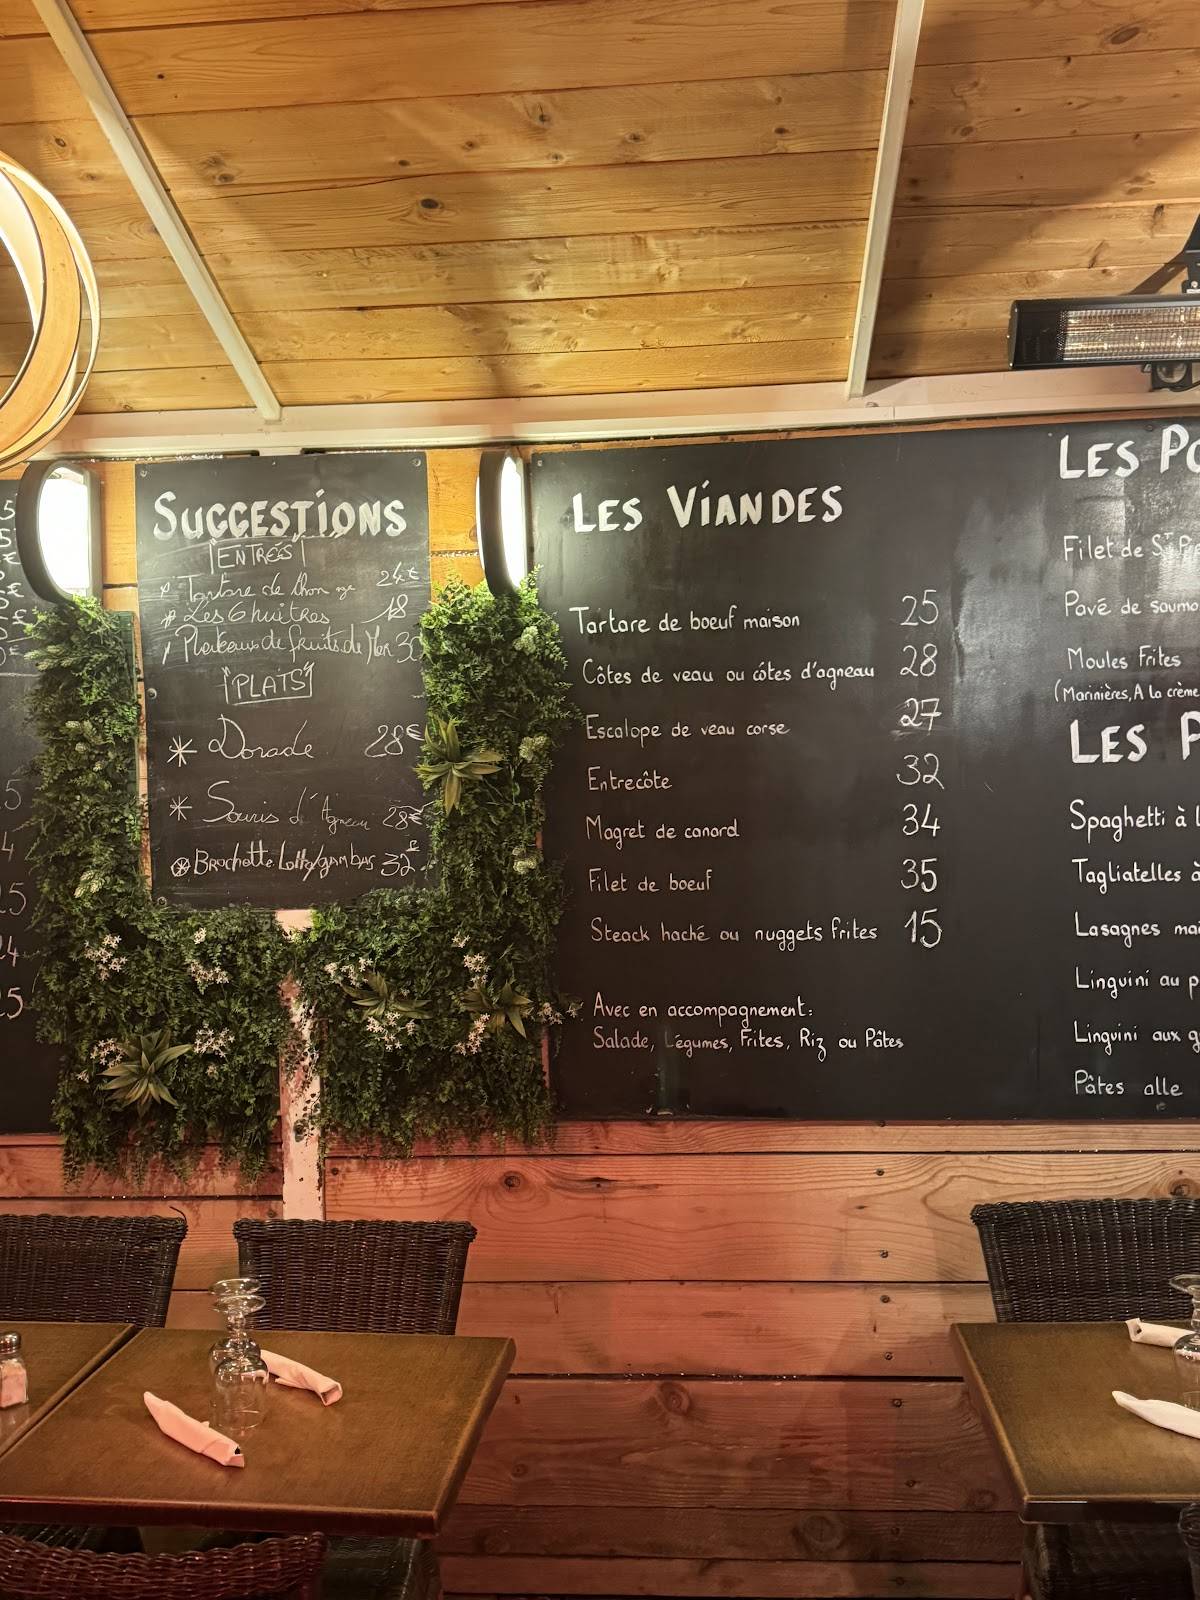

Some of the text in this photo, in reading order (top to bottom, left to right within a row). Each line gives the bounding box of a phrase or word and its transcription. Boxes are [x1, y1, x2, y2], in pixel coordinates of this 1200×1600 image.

[1060, 434, 1140, 480] LES
[572, 492, 643, 533] LES
[1063, 535, 1113, 561] Filet
[1121, 538, 1144, 558] de
[262, 572, 284, 597] de
[1065, 590, 1112, 617] Pavé
[1121, 597, 1142, 615] de
[183, 601, 224, 625] Les
[569, 606, 650, 635] Tartare
[658, 612, 682, 632] de
[743, 608, 800, 631] maison
[900, 589, 939, 626] 25
[582, 658, 632, 685] Côtes
[641, 666, 663, 683] de
[673, 669, 715, 683] veau
[726, 669, 745, 682] ou
[800, 661, 875, 691] d'agneau
[900, 643, 938, 677] 28
[1067, 645, 1182, 670] Moules Frites
[1149, 685, 1162, 699] la
[207, 713, 315, 760] Dorade
[585, 697, 942, 748] Escalope de veau corse 27
[1070, 719, 1148, 764] LES
[588, 753, 945, 791] Entrecôte 32
[202, 780, 280, 824] Souris
[1069, 798, 1165, 844] Spaghetti
[1175, 805, 1187, 827] à
[586, 803, 940, 850] Magret de canard 34
[589, 867, 628, 892] Filet
[638, 876, 660, 892] de
[900, 858, 938, 893] 35
[1071, 857, 1182, 895] Tagliatelles
[590, 908, 943, 951] Steack haché ou nuggets frites 15
[1074, 911, 1161, 949] Lasagnes
[1075, 966, 1150, 999] Linguini
[1159, 975, 1180, 987] au
[593, 991, 631, 1018] Avec
[639, 1005, 658, 1017] en
[592, 1025, 655, 1053] Salade,
[740, 1028, 791, 1051] Frites,
[800, 1027, 827, 1063] Riz
[838, 1037, 858, 1049] ou
[865, 1027, 905, 1049] Pâtes
[1073, 1020, 1138, 1056] Linguini
[1152, 1030, 1182, 1043] aux
[1074, 1069, 1183, 1097] Pâtes alle
